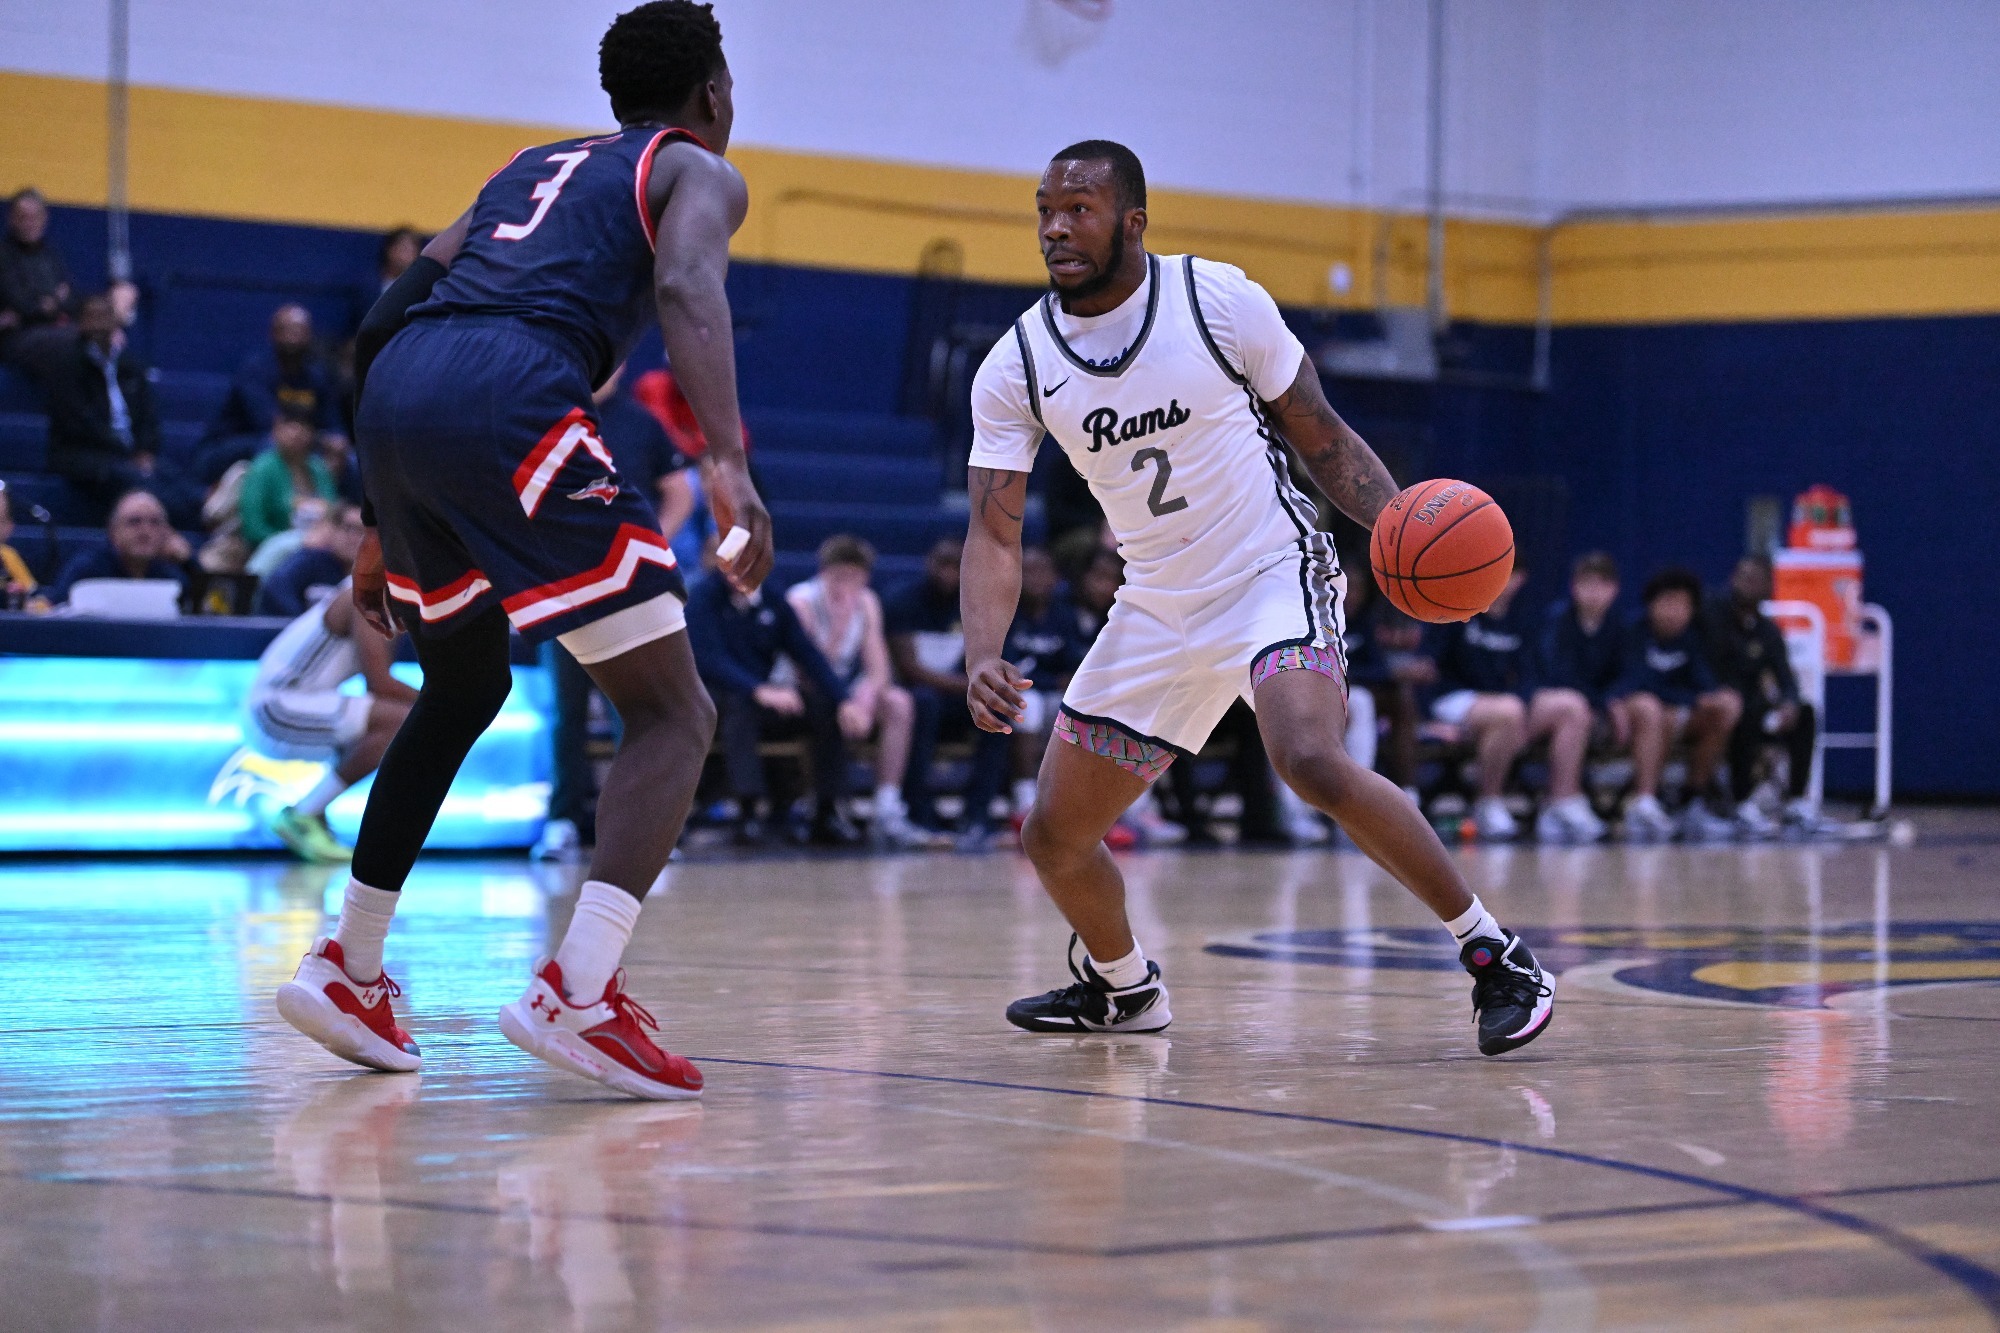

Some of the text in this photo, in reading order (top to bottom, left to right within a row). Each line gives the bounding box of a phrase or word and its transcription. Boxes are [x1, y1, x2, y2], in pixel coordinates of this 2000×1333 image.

[491, 149, 590, 240] 3
[1082, 399, 1191, 453] Rams
[1131, 447, 1189, 517] 2
